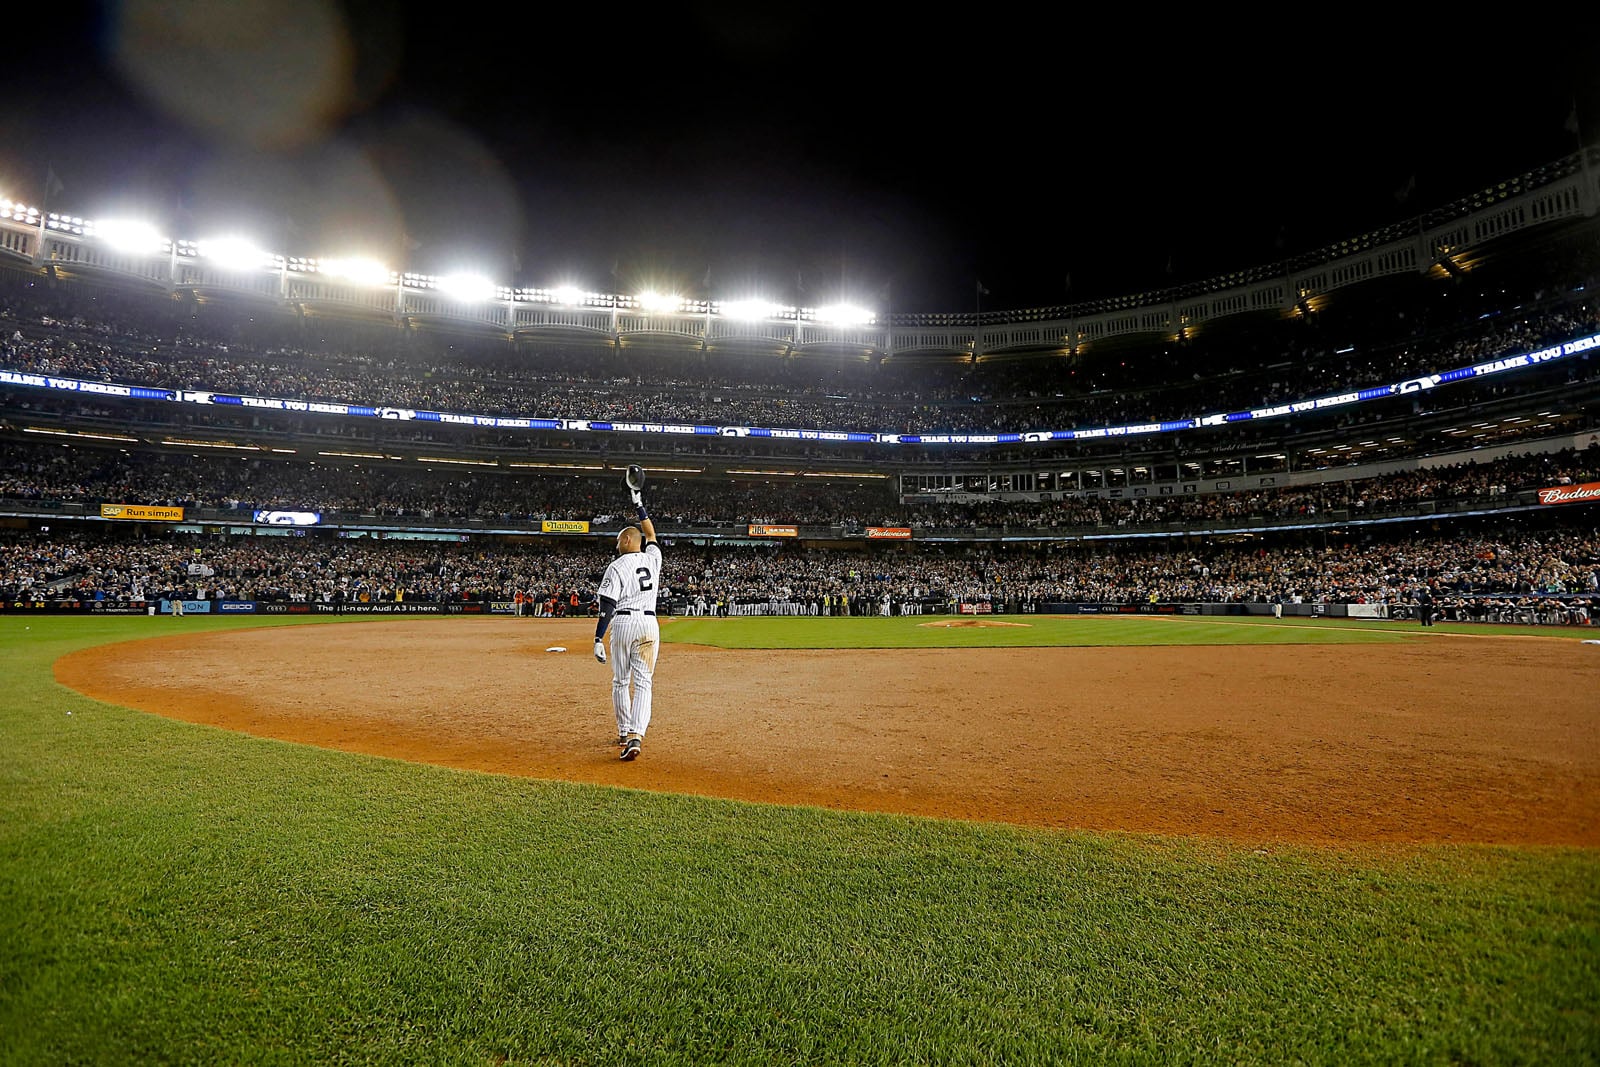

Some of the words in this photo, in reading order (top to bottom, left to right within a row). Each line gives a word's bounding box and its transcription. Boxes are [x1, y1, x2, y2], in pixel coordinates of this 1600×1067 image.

[1473, 356, 1529, 375] THANK
[1530, 346, 1561, 362] YOU
[0, 372, 46, 386] HANK
[48, 378, 78, 389] YOU
[241, 398, 283, 409] THANK
[284, 401, 307, 411] YOU
[1250, 405, 1291, 418] THANK
[1291, 401, 1315, 412] YOU
[439, 414, 475, 424] THANK
[476, 417, 496, 425] YOU
[611, 423, 644, 431] THANK
[645, 424, 663, 432] YOU
[1073, 429, 1106, 438] THANK
[1106, 427, 1126, 435] YOU
[770, 430, 800, 438] THANK
[801, 431, 818, 439] YOU
[1538, 487, 1600, 503] Budwe
[103, 507, 121, 516] SAP
[126, 508, 145, 516] Run
[147, 510, 181, 519] simple.
[866, 529, 911, 537] Budweiser
[636, 567, 652, 591] 2
